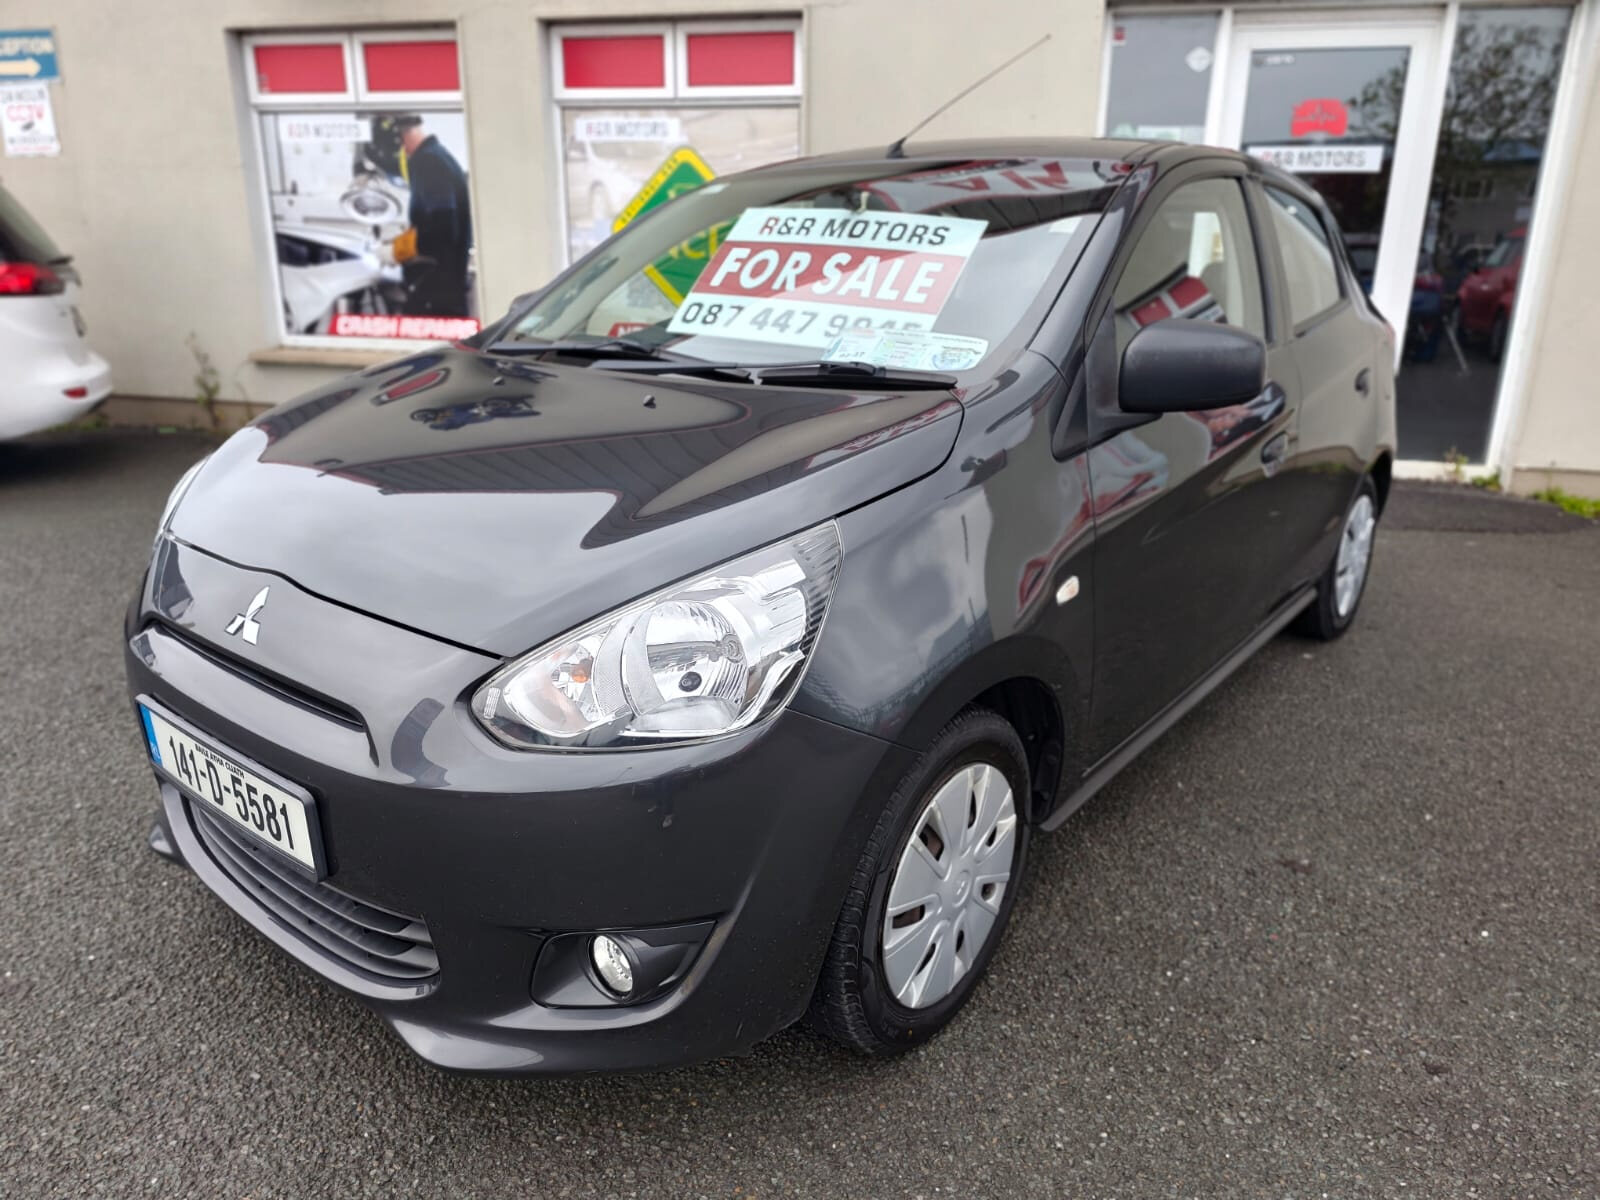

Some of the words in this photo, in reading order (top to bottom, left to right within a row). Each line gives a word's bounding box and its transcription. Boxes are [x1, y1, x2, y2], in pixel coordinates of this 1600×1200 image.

[1297, 150, 1367, 169] MOTORS
[759, 216, 815, 237] R&R
[820, 218, 951, 247] MOTORS
[709, 246, 813, 293] FOR
[811, 250, 945, 304] SALE
[680, 301, 744, 326] 087
[749, 306, 819, 334] 447
[169, 735, 295, 851] 141-D-5581
